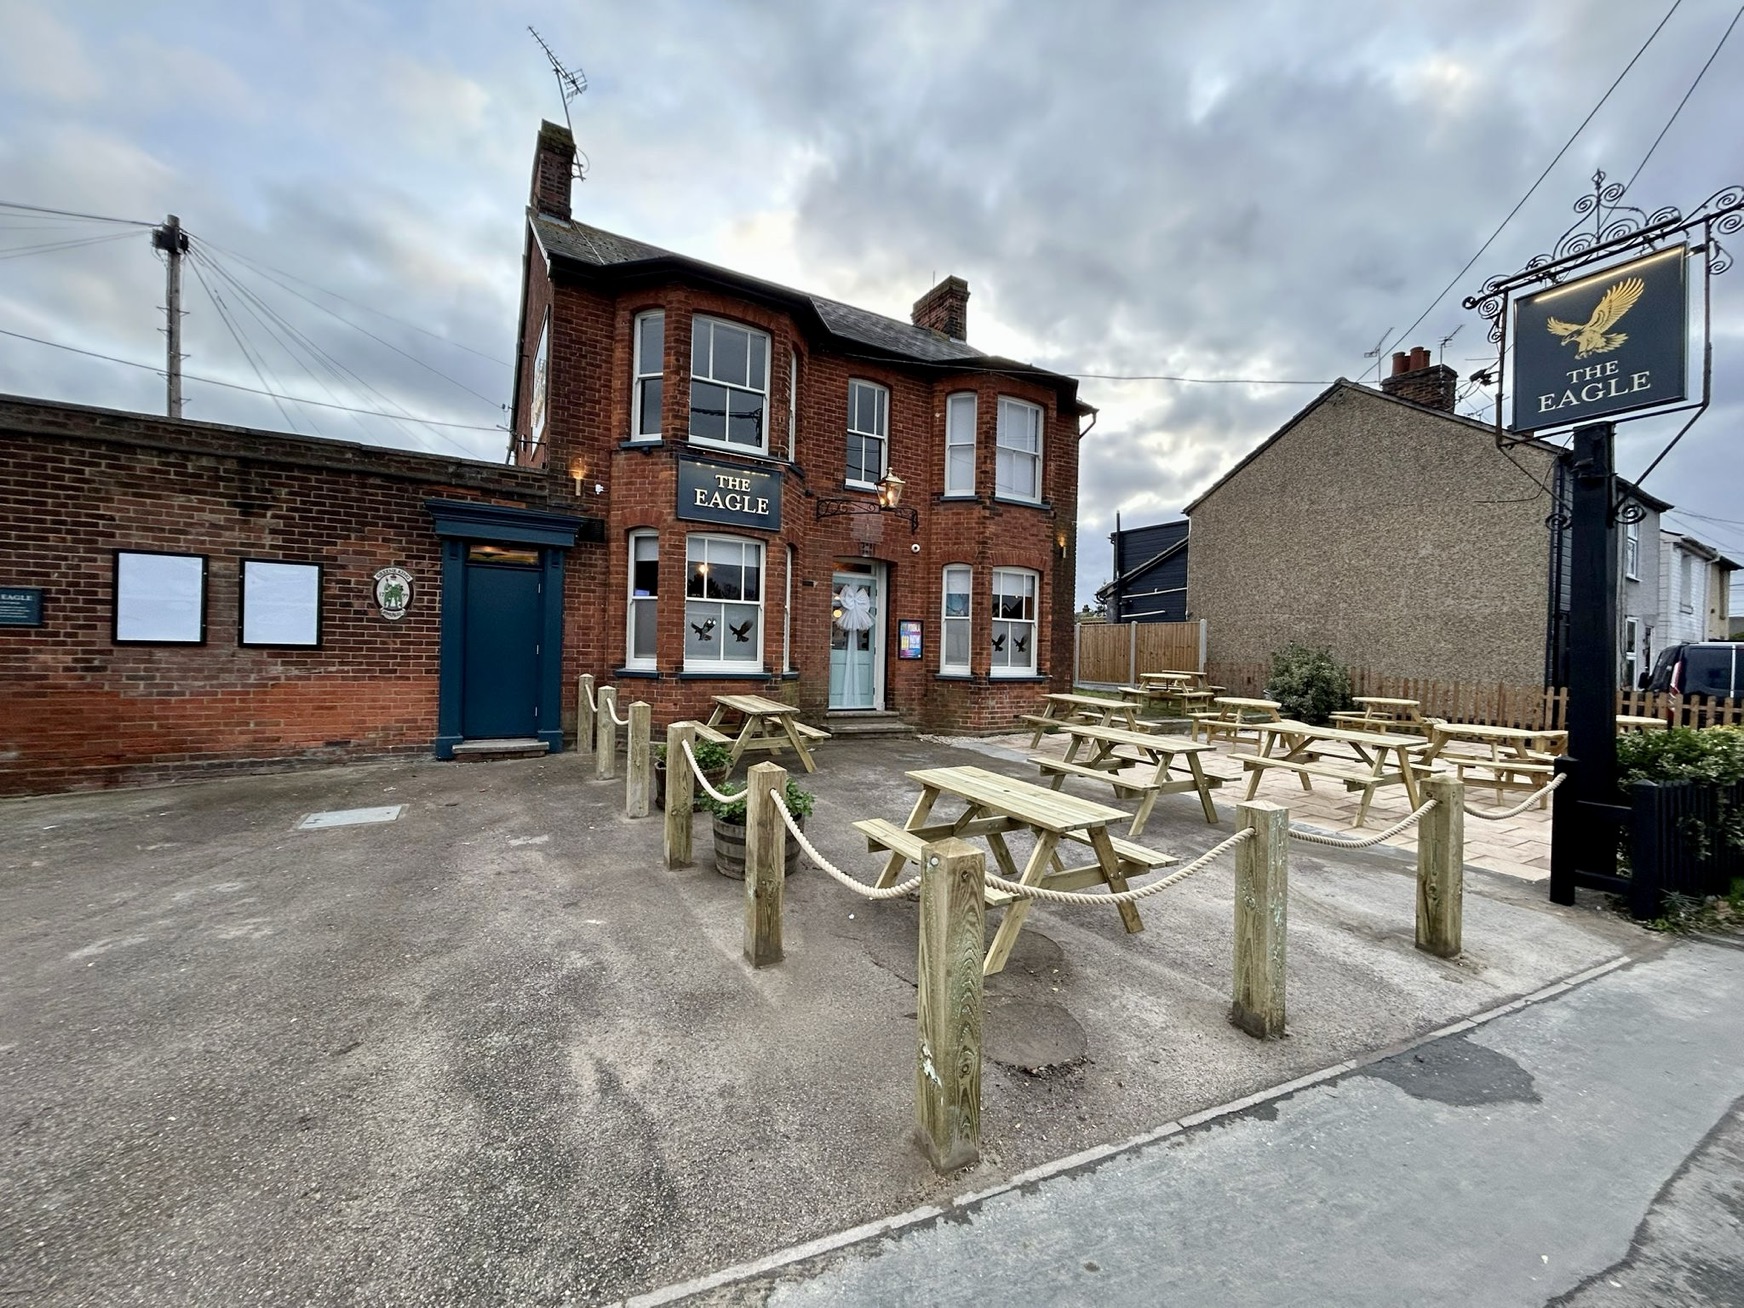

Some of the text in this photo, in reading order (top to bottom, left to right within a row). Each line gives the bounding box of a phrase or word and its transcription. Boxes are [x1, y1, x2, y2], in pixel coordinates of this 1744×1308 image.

[1566, 360, 1619, 384] THE
[1538, 371, 1651, 413] EAGLE
[715, 474, 751, 492] THE
[694, 488, 769, 515] EAGLE
[1, 593, 33, 601] EAGLE
